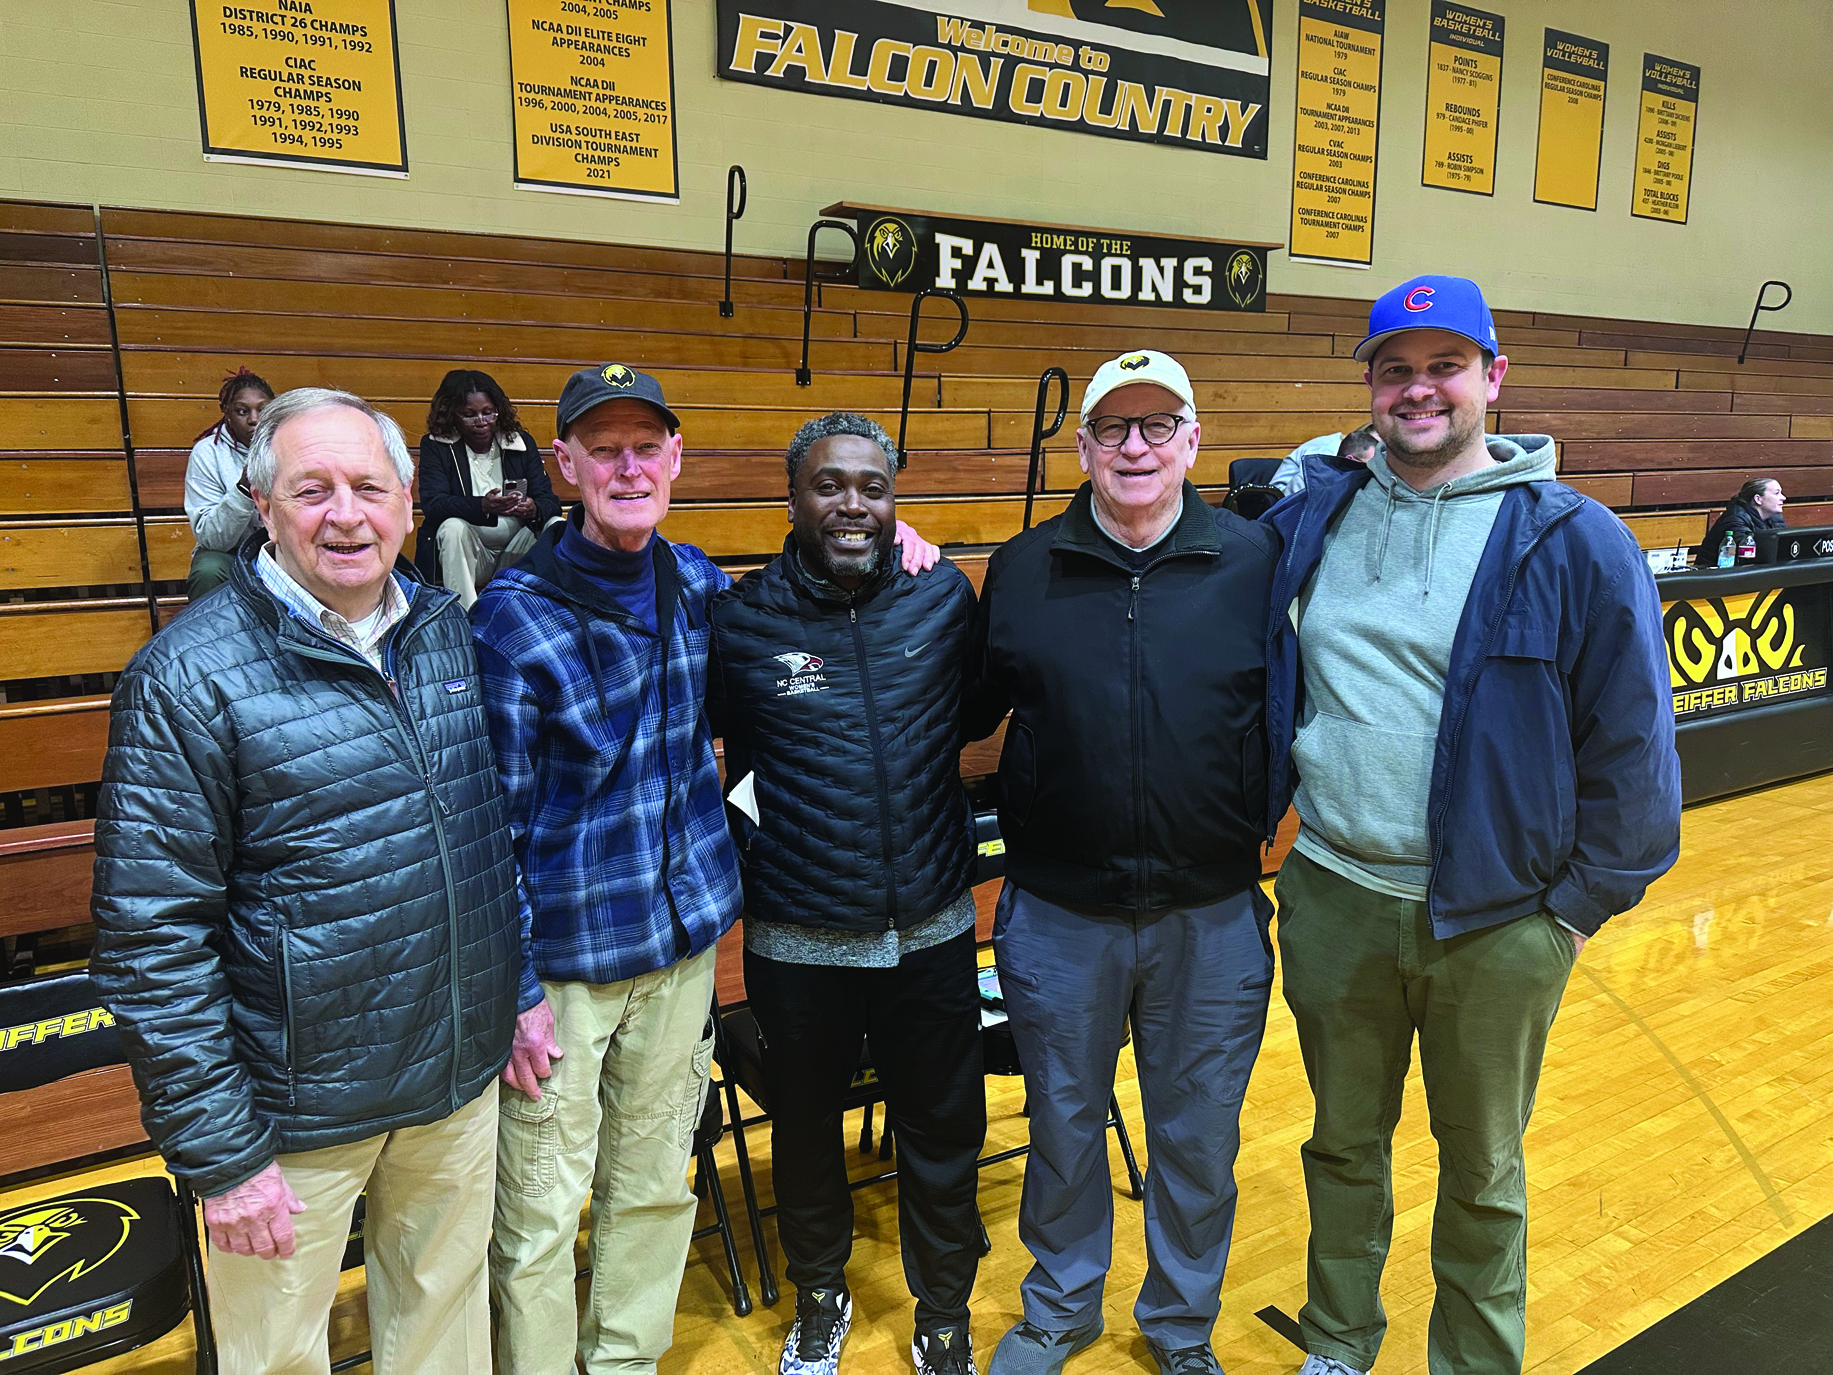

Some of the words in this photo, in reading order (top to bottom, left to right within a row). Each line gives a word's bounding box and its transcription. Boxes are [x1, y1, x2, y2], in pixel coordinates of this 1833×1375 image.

[278, 0, 313, 14] NAIA
[561, 1, 590, 17] 2004,
[593, 7, 618, 20] 2005
[606, 0, 651, 12] CHAMPS
[223, 6, 287, 26] DISTRICT
[291, 17, 307, 29] 26
[310, 19, 368, 37] CHAMPS
[1446, 10, 1493, 28] WOMEN'S
[532, 19, 563, 34] NCAA
[566, 25, 581, 37] DII
[585, 28, 613, 41] ELITE
[616, 33, 647, 47] EIGHT
[1334, 30, 1349, 40] AIAW
[1434, 18, 1501, 41] BASKETBALL
[221, 23, 258, 39] 1985,
[262, 28, 299, 44] 1990,
[302, 34, 338, 50] 1991,
[342, 39, 372, 53] 1992
[937, 16, 1073, 65] Welcome
[1079, 45, 1110, 73] to
[1305, 34, 1335, 47] NATIONAL
[1336, 40, 1375, 56] TOURNAMENT
[552, 36, 630, 57] APPEARANCES
[1557, 41, 1598, 58] WOMEN'S
[579, 55, 605, 67] 2004
[1334, 51, 1347, 60] 1979
[1454, 55, 1478, 69] POINTS
[1547, 48, 1604, 69] VOLLEYBALL
[285, 57, 316, 71] CIAC
[1333, 67, 1346, 76] CIAC
[1452, 66, 1469, 76] NANCY
[1655, 63, 1690, 78] WOMEN'S
[239, 66, 305, 84] REGULAR
[308, 75, 362, 91] SEASON
[570, 76, 599, 89] NCAA
[602, 80, 615, 91] DII
[730, 12, 1003, 109] FALCON
[1009, 61, 1262, 148] COUNTRY
[1301, 70, 1328, 83] REGULAR
[1329, 76, 1351, 88] SEASON
[1353, 81, 1376, 93] CHAMPS
[1547, 74, 1576, 86] CONFERENCE
[1646, 69, 1696, 88] VOLLEYBALL
[274, 86, 332, 103] CHAMPS
[518, 82, 593, 101] TOURNAMENT
[595, 94, 666, 111] APPEARANCES
[1332, 88, 1346, 96] 1979
[1545, 82, 1565, 92] REGULAR
[1566, 87, 1583, 97] SEASON
[1584, 91, 1602, 101] CHAMPS
[248, 99, 285, 114] 1979,
[289, 104, 325, 119] 1985,
[329, 108, 359, 121] 1990
[518, 97, 548, 110] 1996,
[551, 101, 579, 115] 2000,
[582, 105, 610, 118] 2004,
[614, 109, 641, 122] 2005,
[644, 113, 667, 124] 2017
[1326, 103, 1340, 112] NCAA
[1445, 103, 1480, 117] REBOUNDS
[1662, 100, 1676, 110] KILLS
[251, 115, 288, 130] 1991,
[1300, 107, 1337, 120] TOURNAMENT
[1338, 115, 1374, 128] APPEARANCES
[1449, 114, 1471, 125] CANDACE
[1472, 119, 1488, 128] PHIFER
[550, 123, 572, 135] USA
[575, 126, 611, 139] SOUTH
[615, 131, 640, 143] EAST
[1314, 120, 1329, 131] 2003,
[1331, 123, 1345, 134] 2007,
[1347, 126, 1360, 135] 2013
[1656, 130, 1676, 141] ASSISTS
[272, 132, 308, 147] 1994,
[311, 136, 342, 149] 1995
[532, 135, 582, 149] DIVISION
[585, 141, 658, 158] TOURNAMENT
[1329, 140, 1344, 148] CVAC
[575, 153, 620, 167] CHAMPS
[1298, 144, 1325, 155] REGULAR
[1326, 149, 1348, 159] SEASON
[1349, 153, 1372, 163] CHAMPS
[1447, 152, 1473, 164] ASSISTS
[1329, 160, 1342, 168] 2003
[1447, 162, 1462, 171] ROBIN
[1463, 165, 1484, 175] SIMPSON
[1658, 161, 1670, 170] DIGS
[586, 168, 611, 179] 2021
[1299, 171, 1337, 184] CONFERENCE
[1338, 177, 1369, 188] CAROLINAS
[1297, 181, 1323, 192] REGULAR
[1325, 185, 1346, 195] SEASON
[1348, 189, 1371, 199] CHAMPS
[1644, 189, 1659, 198] TOTAL
[1660, 192, 1679, 202] BLOCKS
[1298, 207, 1335, 219] CONFERENCE
[1336, 213, 1367, 223] CAROLINAS
[1300, 218, 1340, 229] TOURNAMENT
[1341, 223, 1364, 232] CHAMPS
[1326, 231, 1339, 239] 2007
[1031, 232, 1076, 251] HOME
[1079, 237, 1097, 252] OF
[1100, 239, 1131, 255] THE
[934, 232, 1213, 304] FALCONS
[1404, 286, 1435, 312] C
[777, 679, 787, 687] NC
[790, 674, 826, 685] CENTRAL
[1742, 667, 1827, 702] FALCONS
